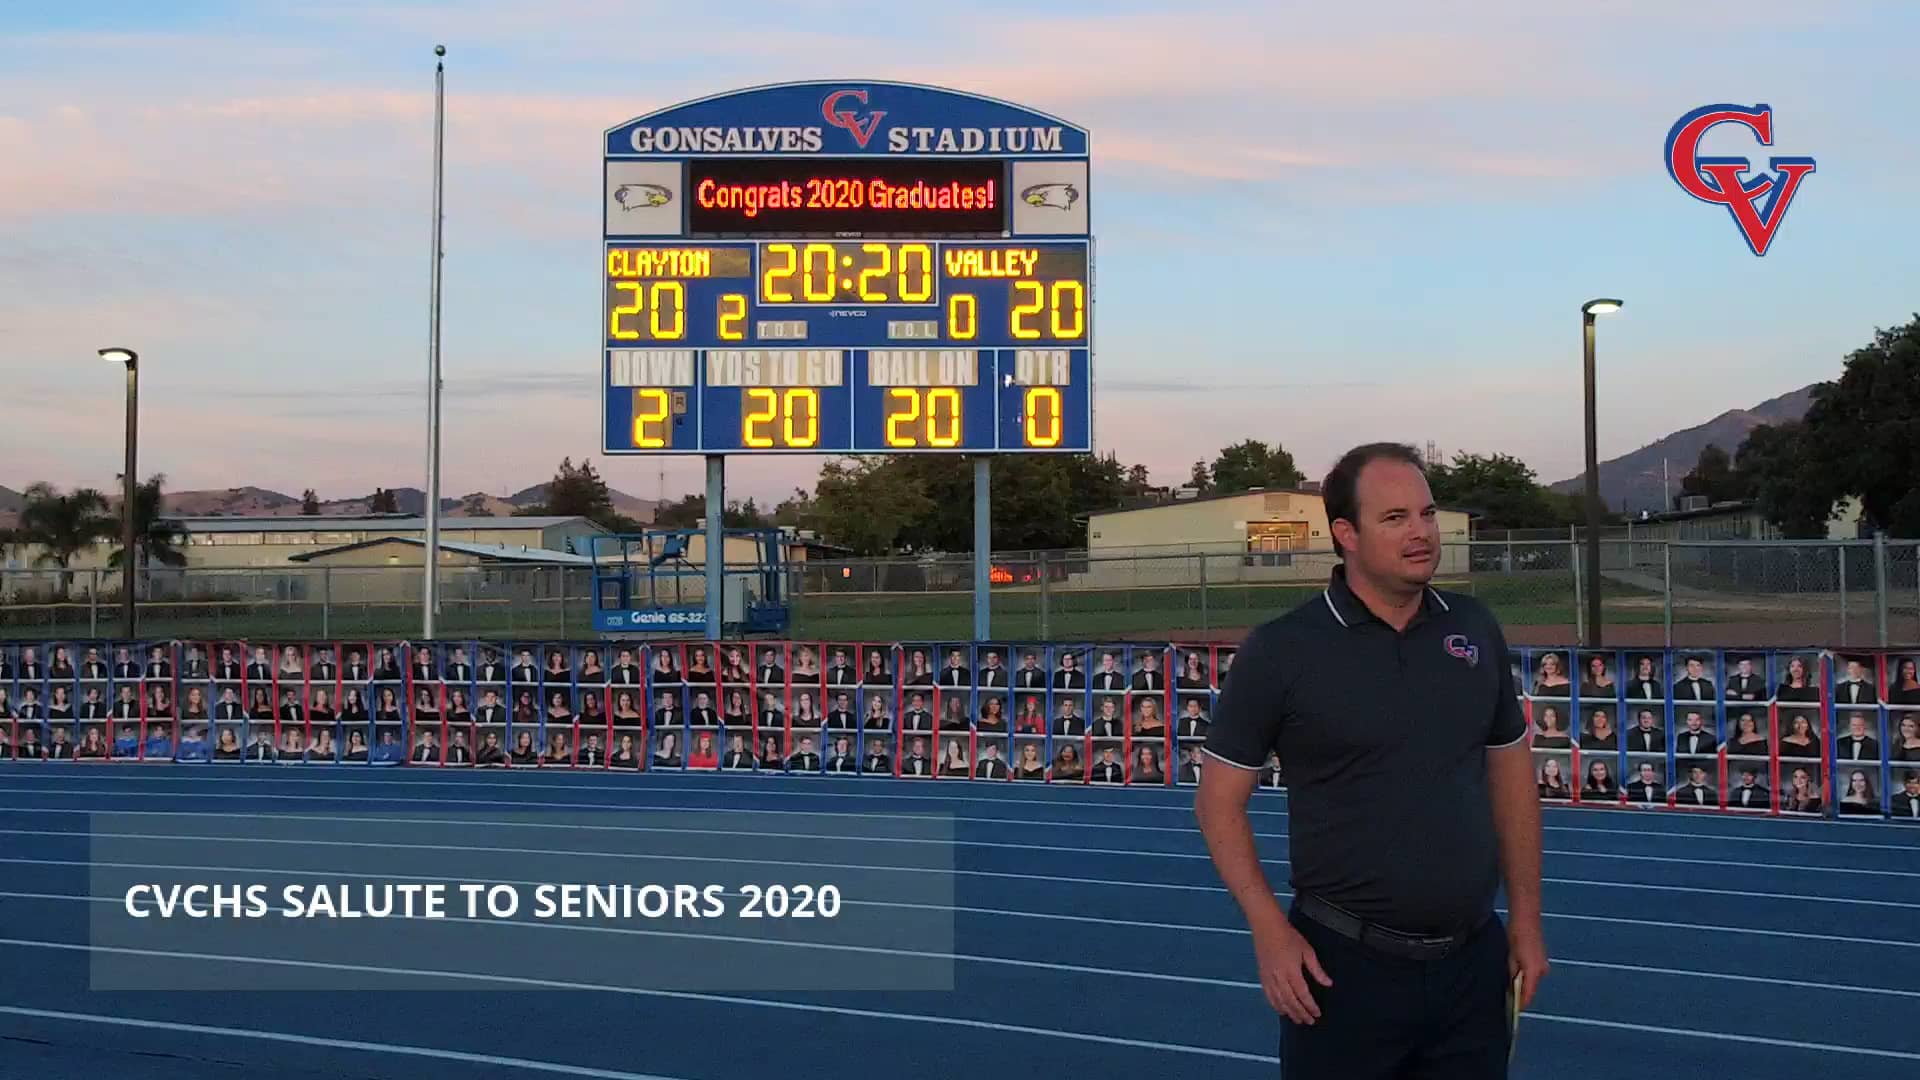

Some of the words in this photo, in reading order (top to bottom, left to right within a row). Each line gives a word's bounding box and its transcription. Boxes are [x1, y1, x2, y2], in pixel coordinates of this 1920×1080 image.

[630, 127, 823, 153] GONSALVES
[888, 126, 1063, 153] STADIUM
[697, 179, 803, 218] Congrats
[806, 180, 864, 209] 2020
[868, 179, 996, 210] Graduates!
[607, 249, 711, 277] CLAYTON
[762, 243, 933, 303] 20:20
[945, 249, 1039, 277] VALLEY
[609, 281, 686, 340] 20
[718, 293, 747, 341] 2
[947, 293, 976, 340] 0
[1010, 280, 1085, 339] 20
[614, 352, 692, 385] DOWN
[712, 352, 762, 385] YDS
[768, 352, 799, 385] TO
[806, 352, 841, 385] GO
[873, 352, 926, 385] BALL
[940, 352, 972, 385] ON
[1018, 352, 1068, 385] QTR
[633, 388, 669, 447] 2
[742, 388, 819, 447] 20
[885, 388, 962, 447] 20
[1025, 388, 1061, 447] 0
[631, 611, 666, 623] Genie
